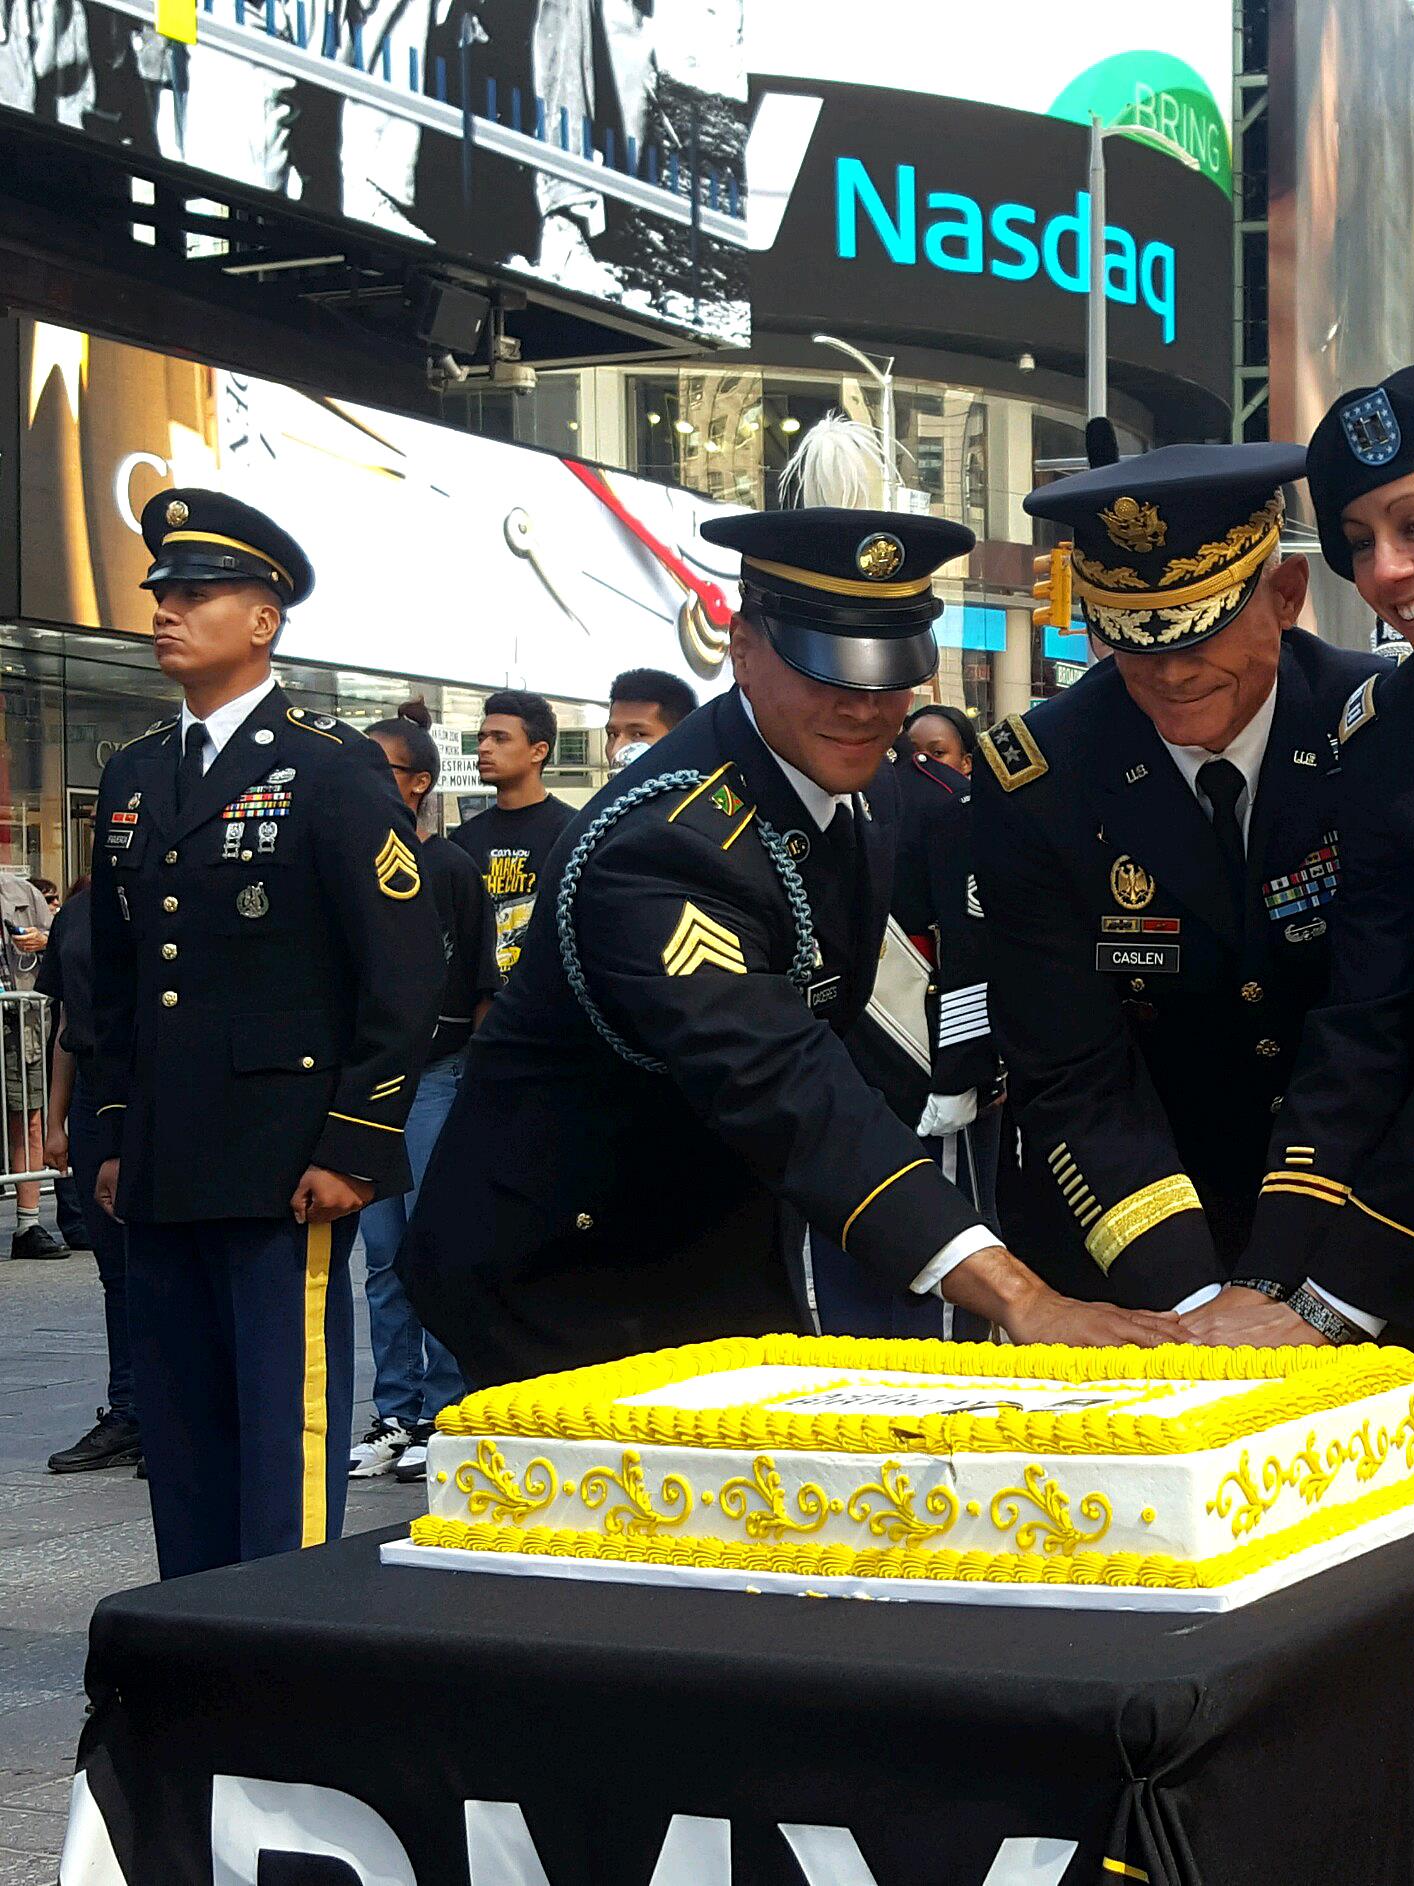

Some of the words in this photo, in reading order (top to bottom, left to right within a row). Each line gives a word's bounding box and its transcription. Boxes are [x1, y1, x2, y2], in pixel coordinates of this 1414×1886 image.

[1135, 82, 1221, 173] BRING
[835, 156, 1176, 345] Nasdaq
[490, 849, 511, 857] can
[512, 849, 530, 864] you
[491, 857, 527, 877] MAKE
[1112, 951, 1164, 965] CASLEN
